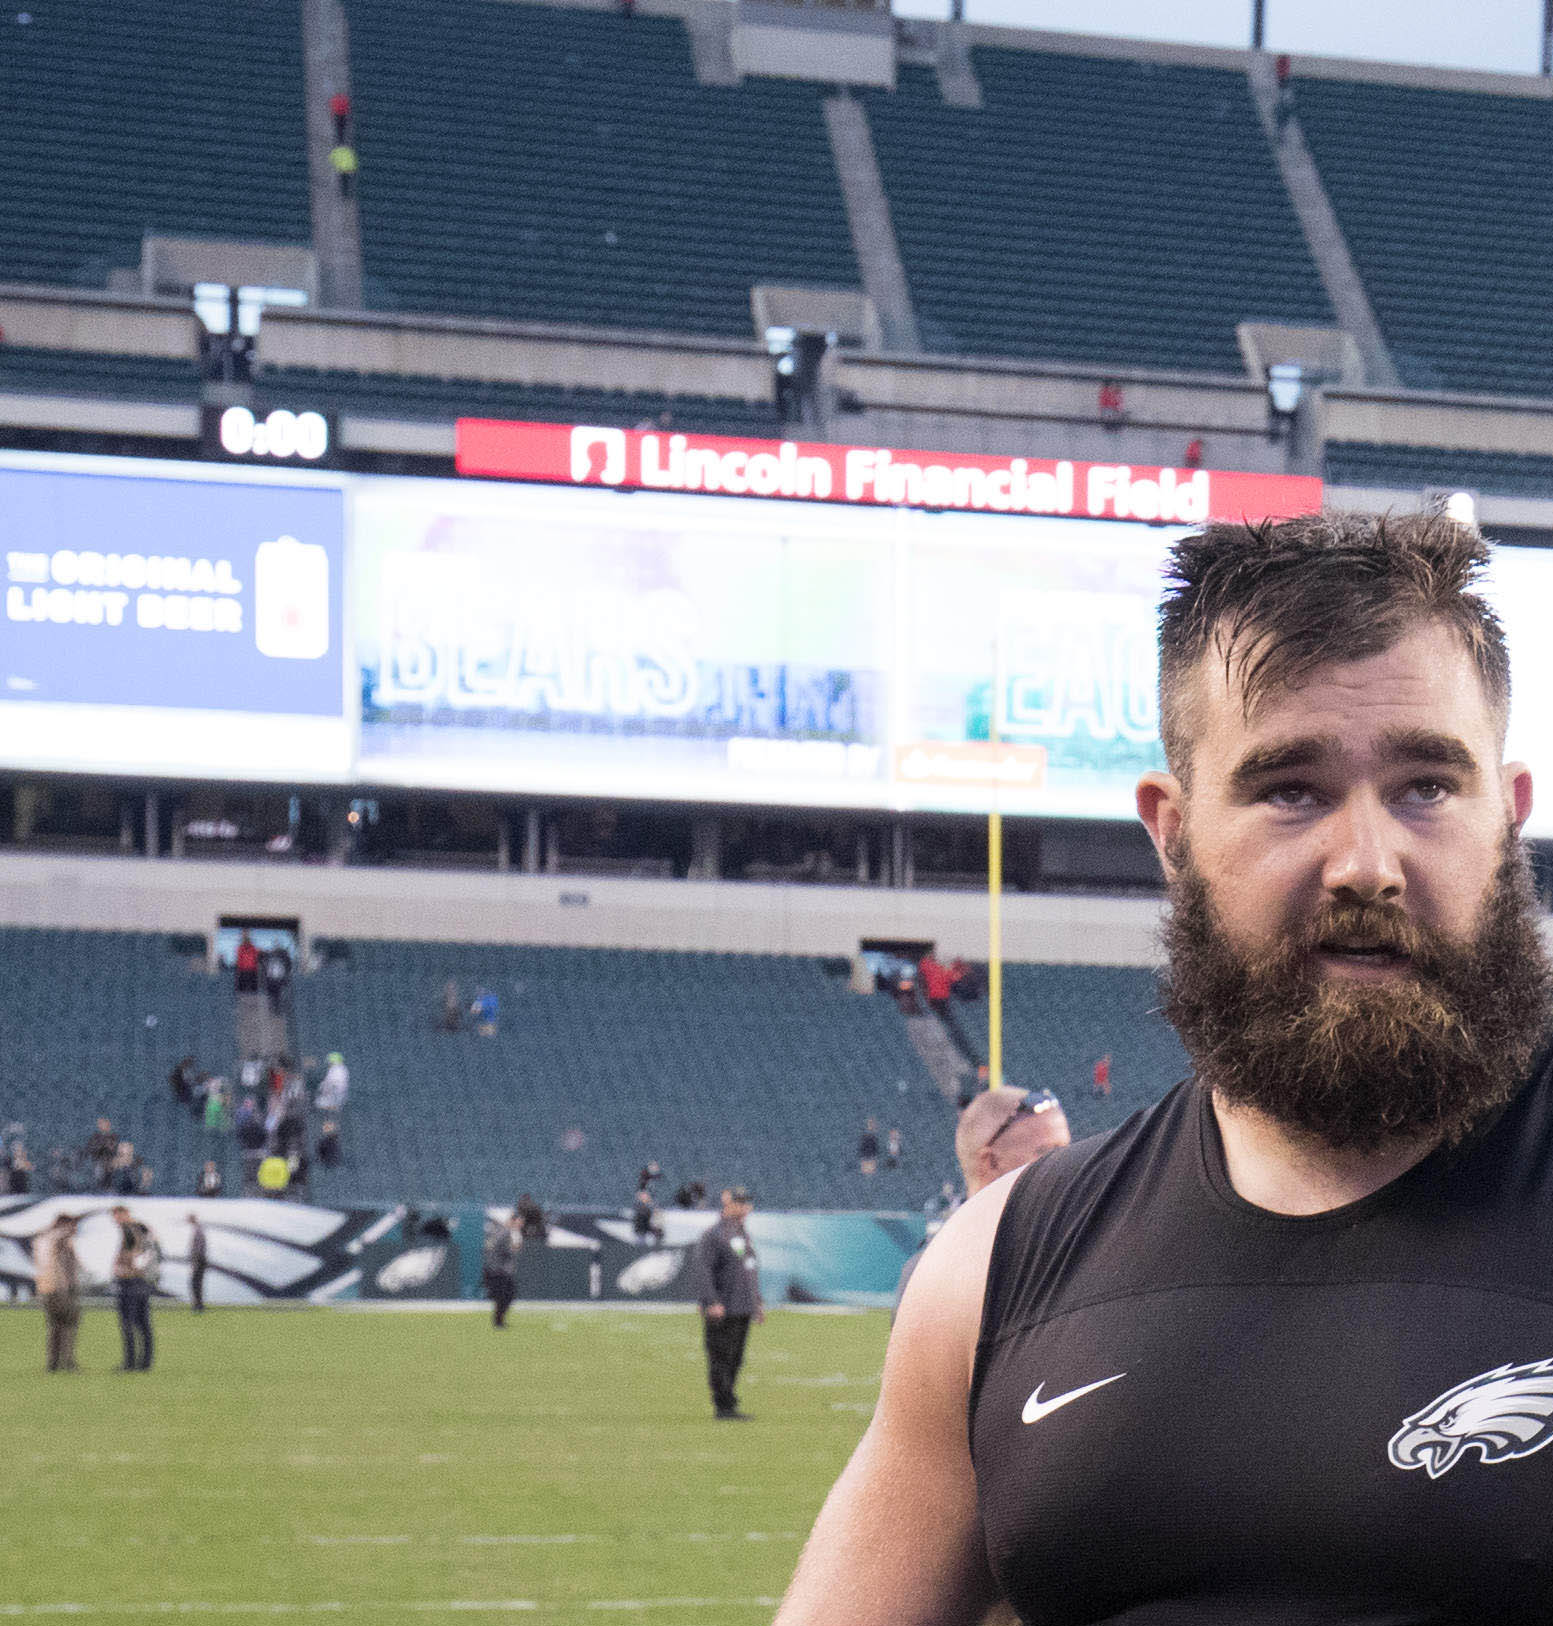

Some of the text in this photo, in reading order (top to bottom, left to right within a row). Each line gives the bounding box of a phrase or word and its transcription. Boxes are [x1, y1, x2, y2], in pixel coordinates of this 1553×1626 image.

[641, 433, 1210, 522] Lincoln Financial Field
